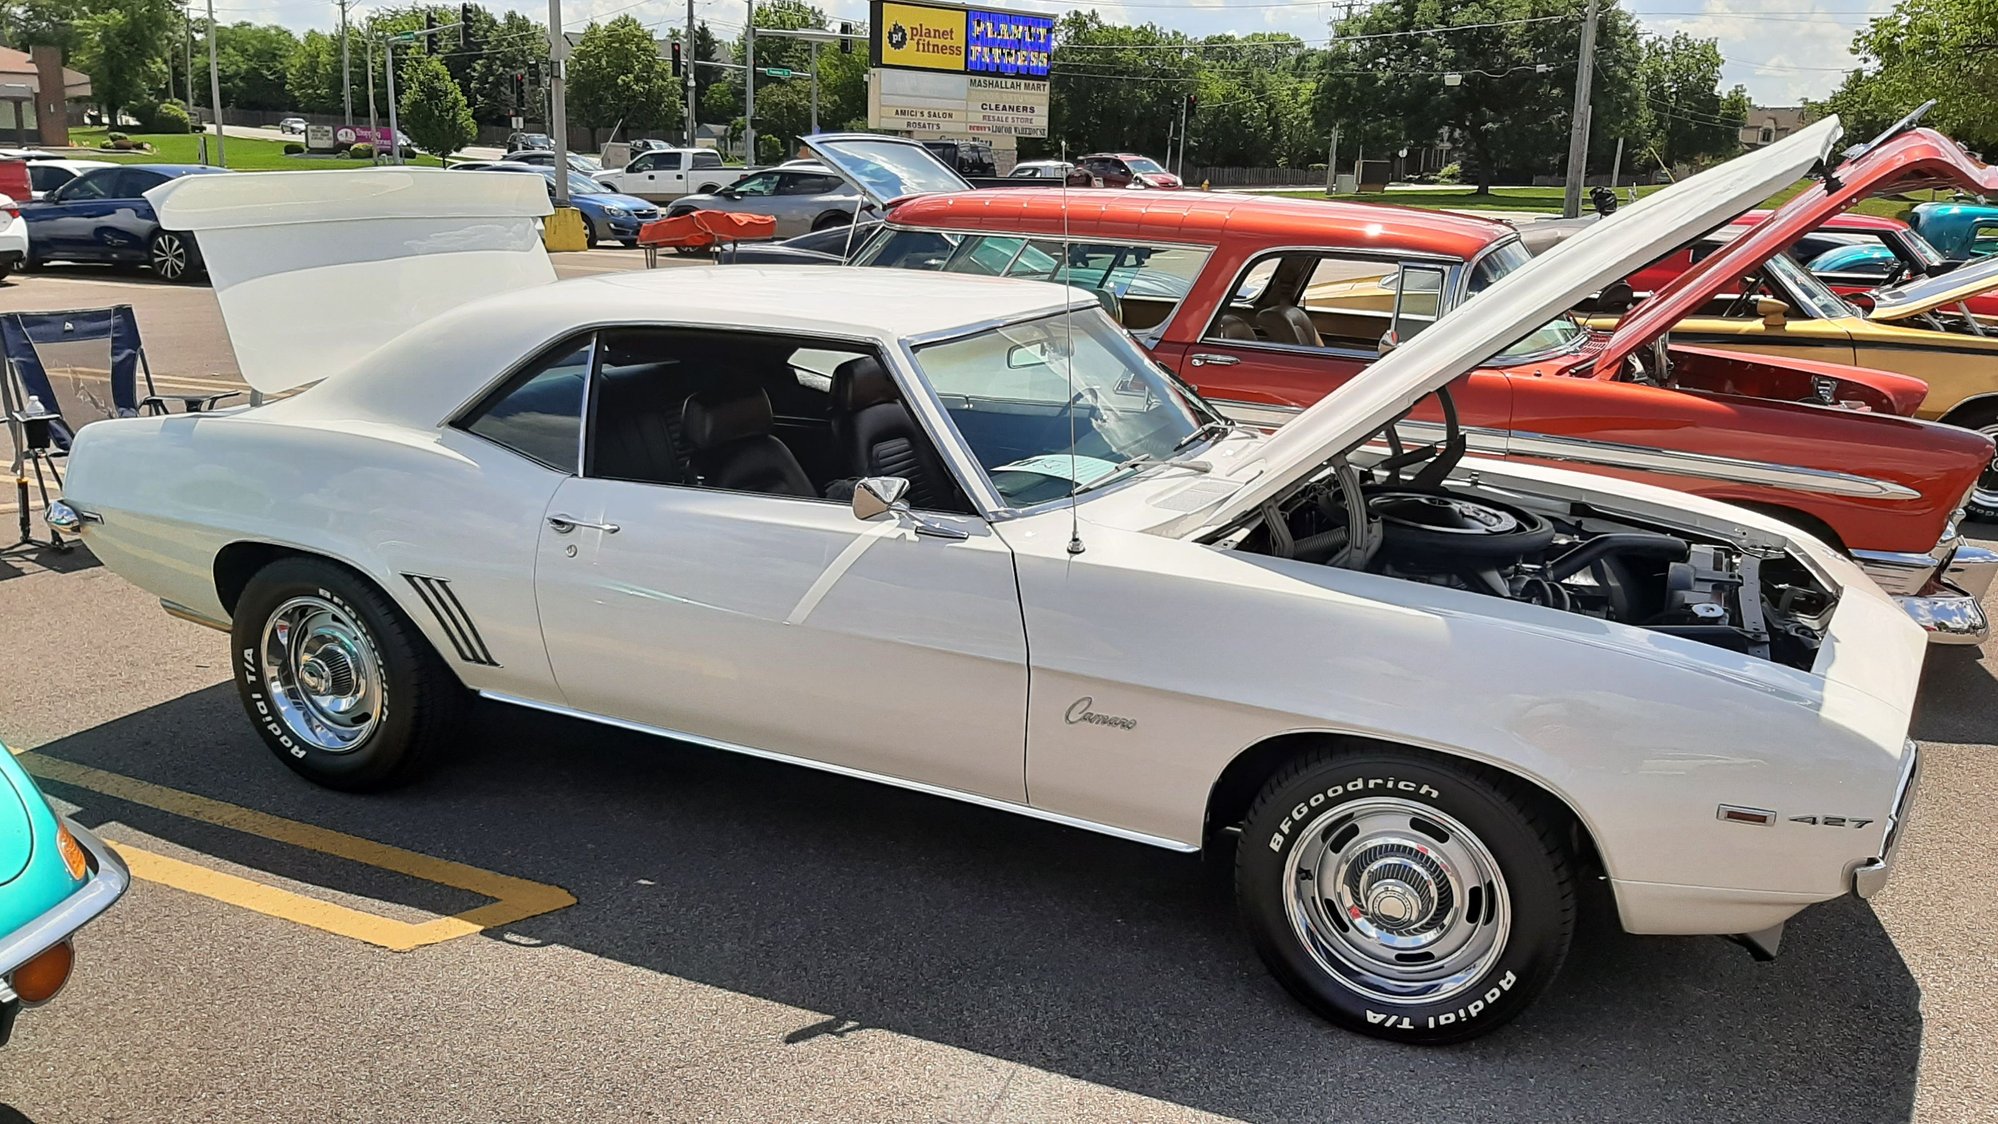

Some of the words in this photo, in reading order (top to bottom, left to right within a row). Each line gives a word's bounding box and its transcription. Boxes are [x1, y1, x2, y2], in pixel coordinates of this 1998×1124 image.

[892, 31, 902, 43] pf
[909, 23, 954, 41] planet
[915, 38, 962, 56] fitness
[969, 78, 1021, 90] MASHALLAH
[1024, 82, 1047, 92] MART
[927, 110, 953, 119] SALON
[981, 103, 1036, 114] CLEANERS
[906, 121, 941, 130] ROSATI'S
[982, 114, 1009, 123] RESALE
[1011, 116, 1034, 125] STORE
[243, 648, 257, 685] T/A
[1065, 696, 1137, 730] Camaro
[251, 693, 308, 760] Radial
[1269, 776, 1440, 853] BFGoodrich
[1788, 815, 1874, 829] 427
[1428, 970, 1517, 1029] Radial
[1365, 1009, 1415, 1030] T/A
